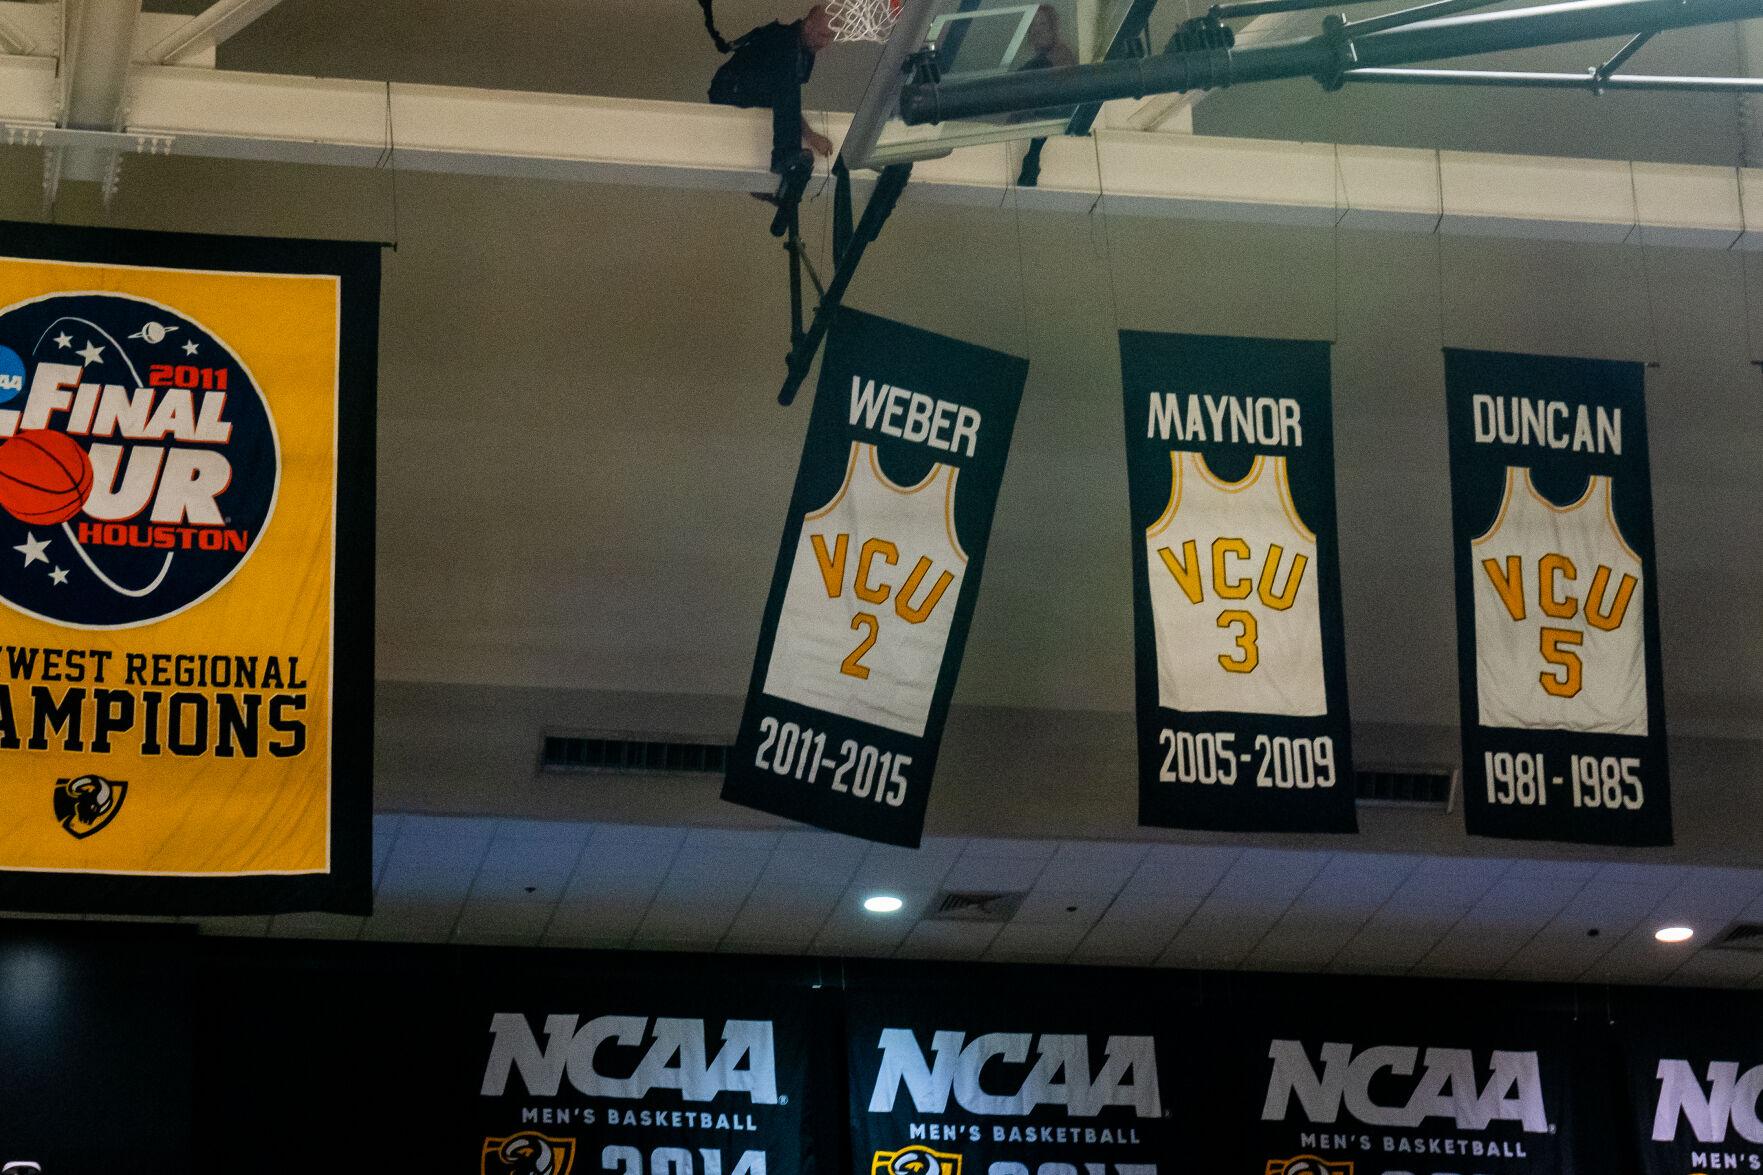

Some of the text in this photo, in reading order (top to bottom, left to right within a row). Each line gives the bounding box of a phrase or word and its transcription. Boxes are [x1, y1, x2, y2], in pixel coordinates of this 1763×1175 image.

[19, 362, 234, 444] FINAL
[149, 364, 228, 390] 2011
[848, 375, 982, 458] WEBER
[1147, 391, 1303, 447] MAYNOR
[1472, 394, 1623, 456] DUNCAN
[78, 522, 248, 553] HOUSTON
[810, 533, 955, 625] VCU
[1157, 536, 1308, 612] VCU
[1481, 552, 1639, 632] VCU
[0, 646, 307, 690] WEST REGIONAL
[840, 612, 879, 681] 2
[1216, 608, 1260, 674] 3
[1539, 627, 1584, 699] 5
[754, 716, 913, 808] 2011-2015
[480, 1012, 778, 1105] NCAA
[868, 1027, 1163, 1119] NCAA
[1260, 1038, 1549, 1134] NCAA
[521, 1107, 757, 1131] MEN'S BASKETBALL
[909, 1122, 1140, 1144] MEN'S BASKETBALL
[1301, 1133, 1527, 1158] MEN'S BASKETBALL
[1691, 1151, 1761, 1170] MEN'S
